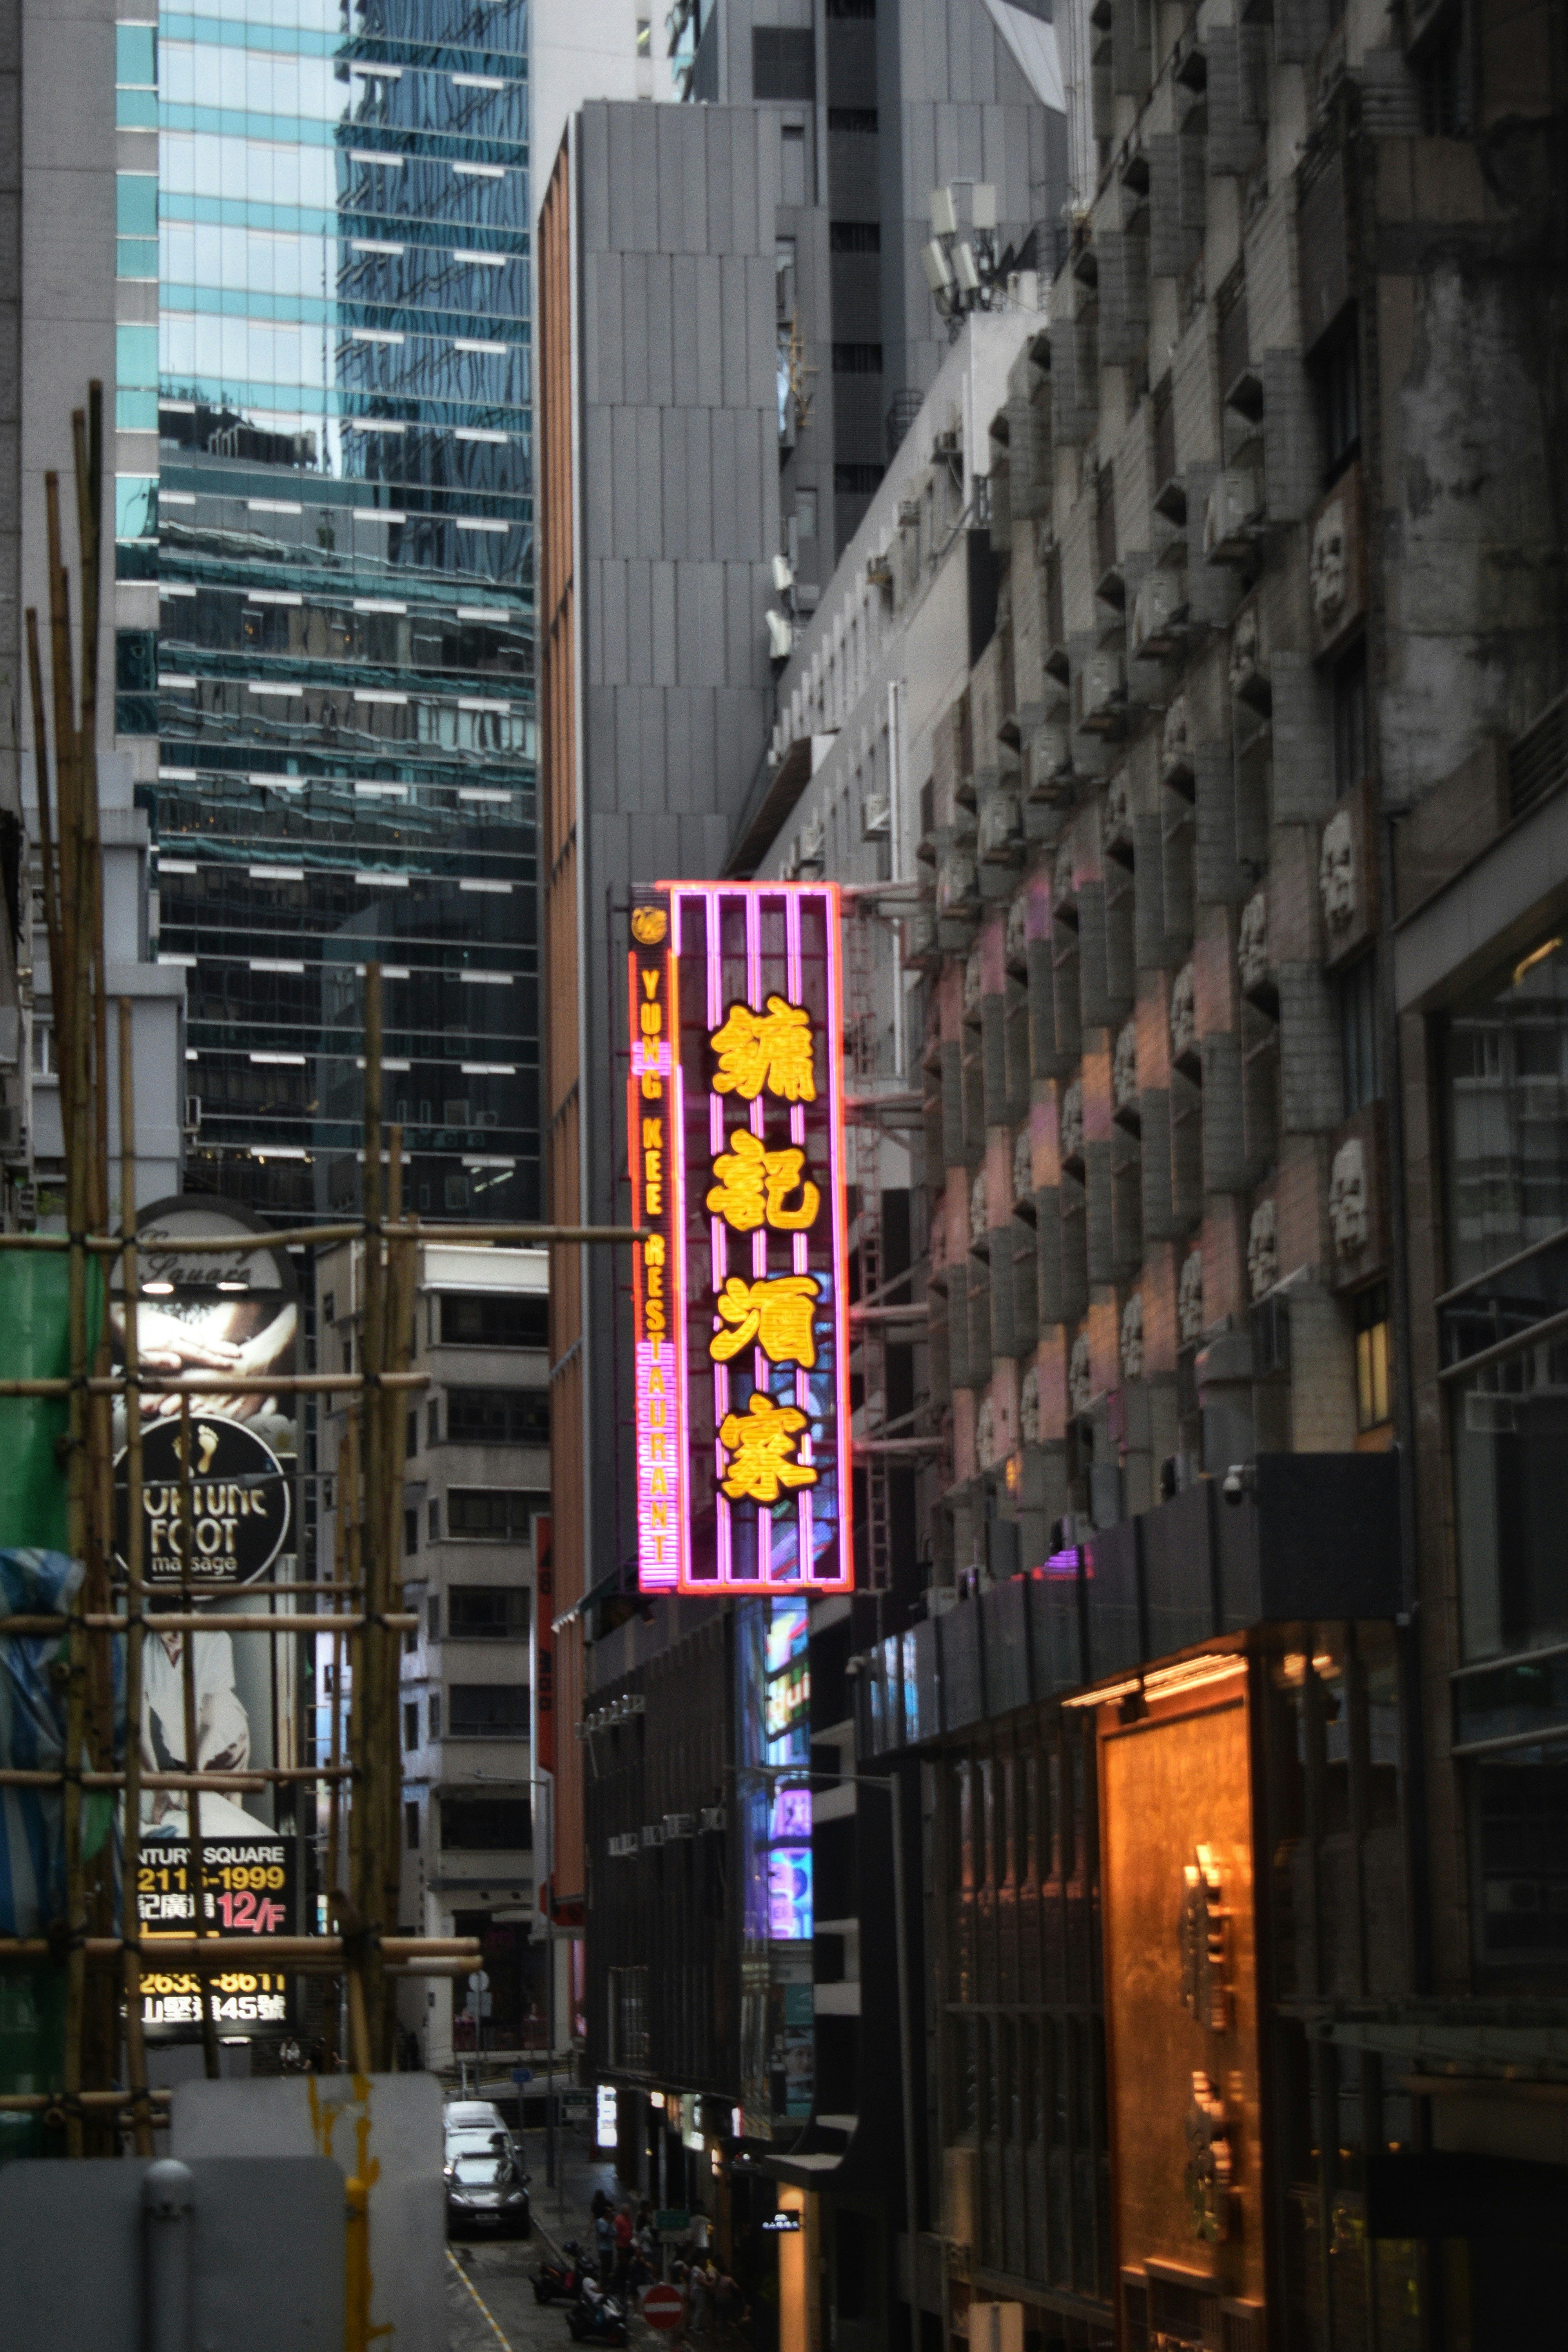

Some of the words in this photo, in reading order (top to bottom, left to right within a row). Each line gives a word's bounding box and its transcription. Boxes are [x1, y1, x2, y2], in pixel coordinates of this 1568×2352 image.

[640, 970, 662, 1099] YUNG
[642, 1118, 663, 1214] KEE
[706, 996, 820, 1501] 鏞記酒家
[644, 1234, 668, 1562] RESTAURANT
[151, 1556, 238, 1576] masage
[203, 1846, 285, 1864] SQUARE
[218, 1891, 286, 1933] 12/F
